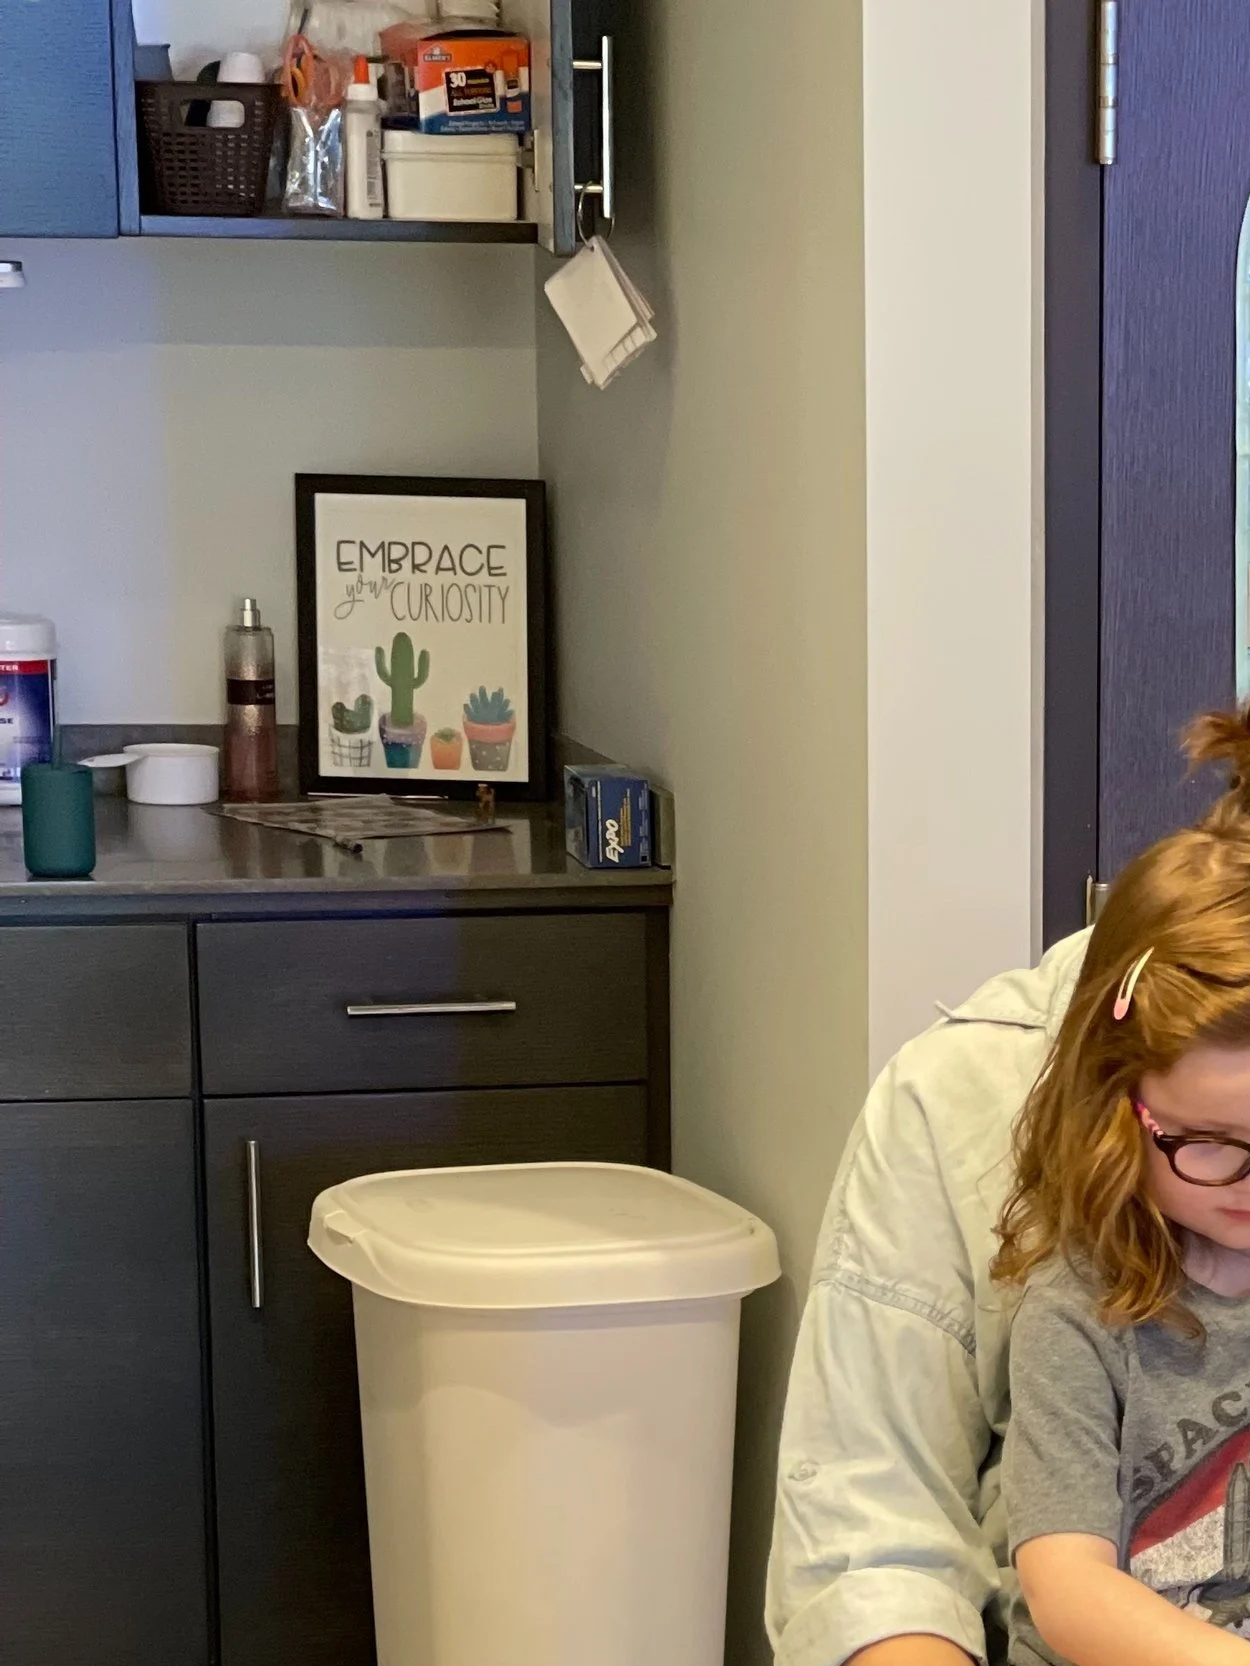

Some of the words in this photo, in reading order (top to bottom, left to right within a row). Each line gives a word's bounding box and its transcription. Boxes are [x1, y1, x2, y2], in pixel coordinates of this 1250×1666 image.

[449, 72, 466, 87] 30
[336, 539, 508, 577] EMBRACE
[334, 574, 396, 620] your
[390, 581, 510, 624] CURIOSITY
